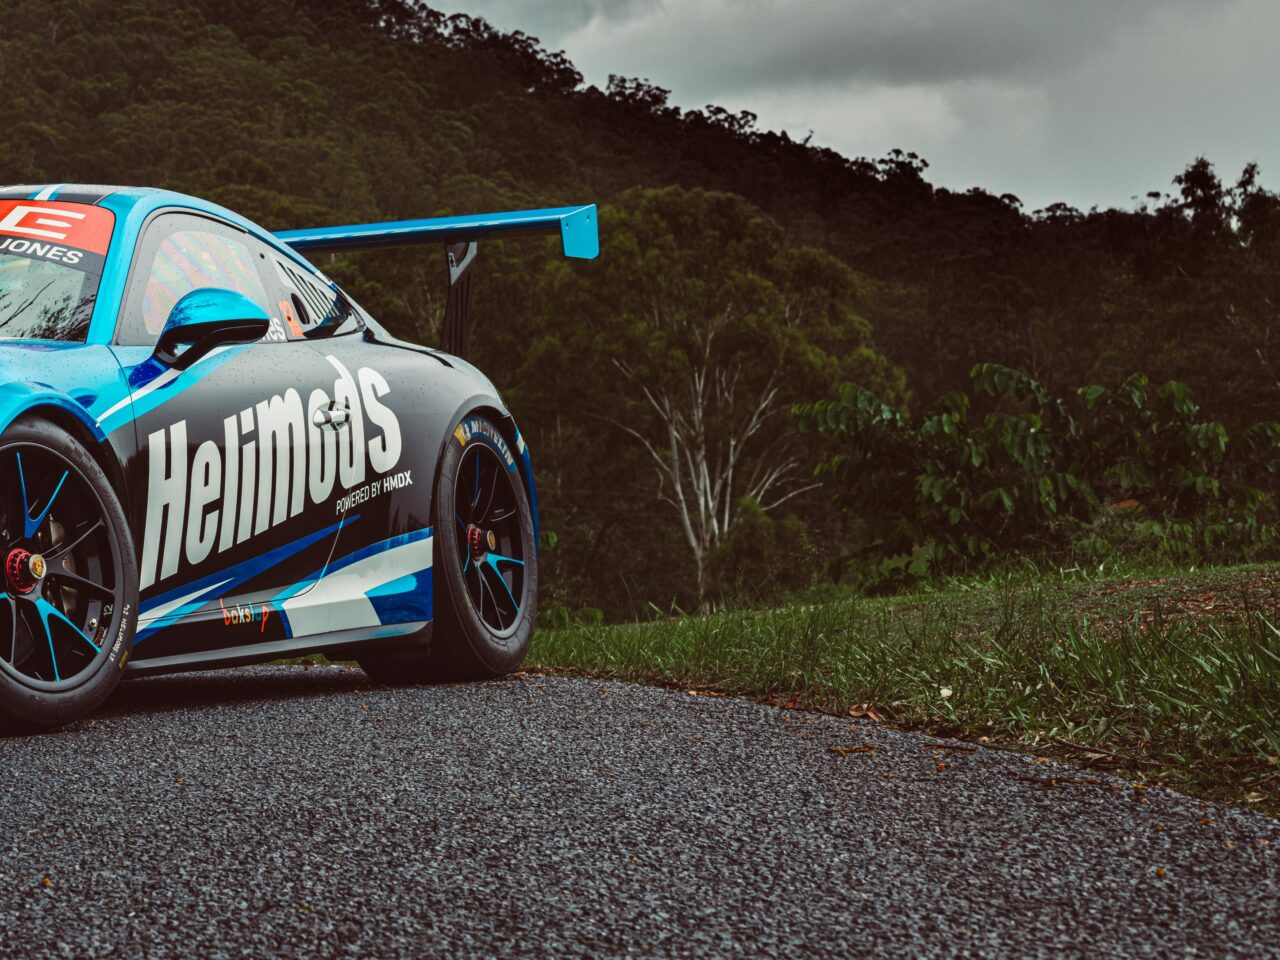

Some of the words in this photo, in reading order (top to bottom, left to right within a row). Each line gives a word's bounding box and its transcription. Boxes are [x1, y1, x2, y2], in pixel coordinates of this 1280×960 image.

[139, 355, 402, 592] Helimods
[336, 486, 370, 516] POWERED
[371, 480, 382, 498] BY
[383, 470, 413, 493] HMDX
